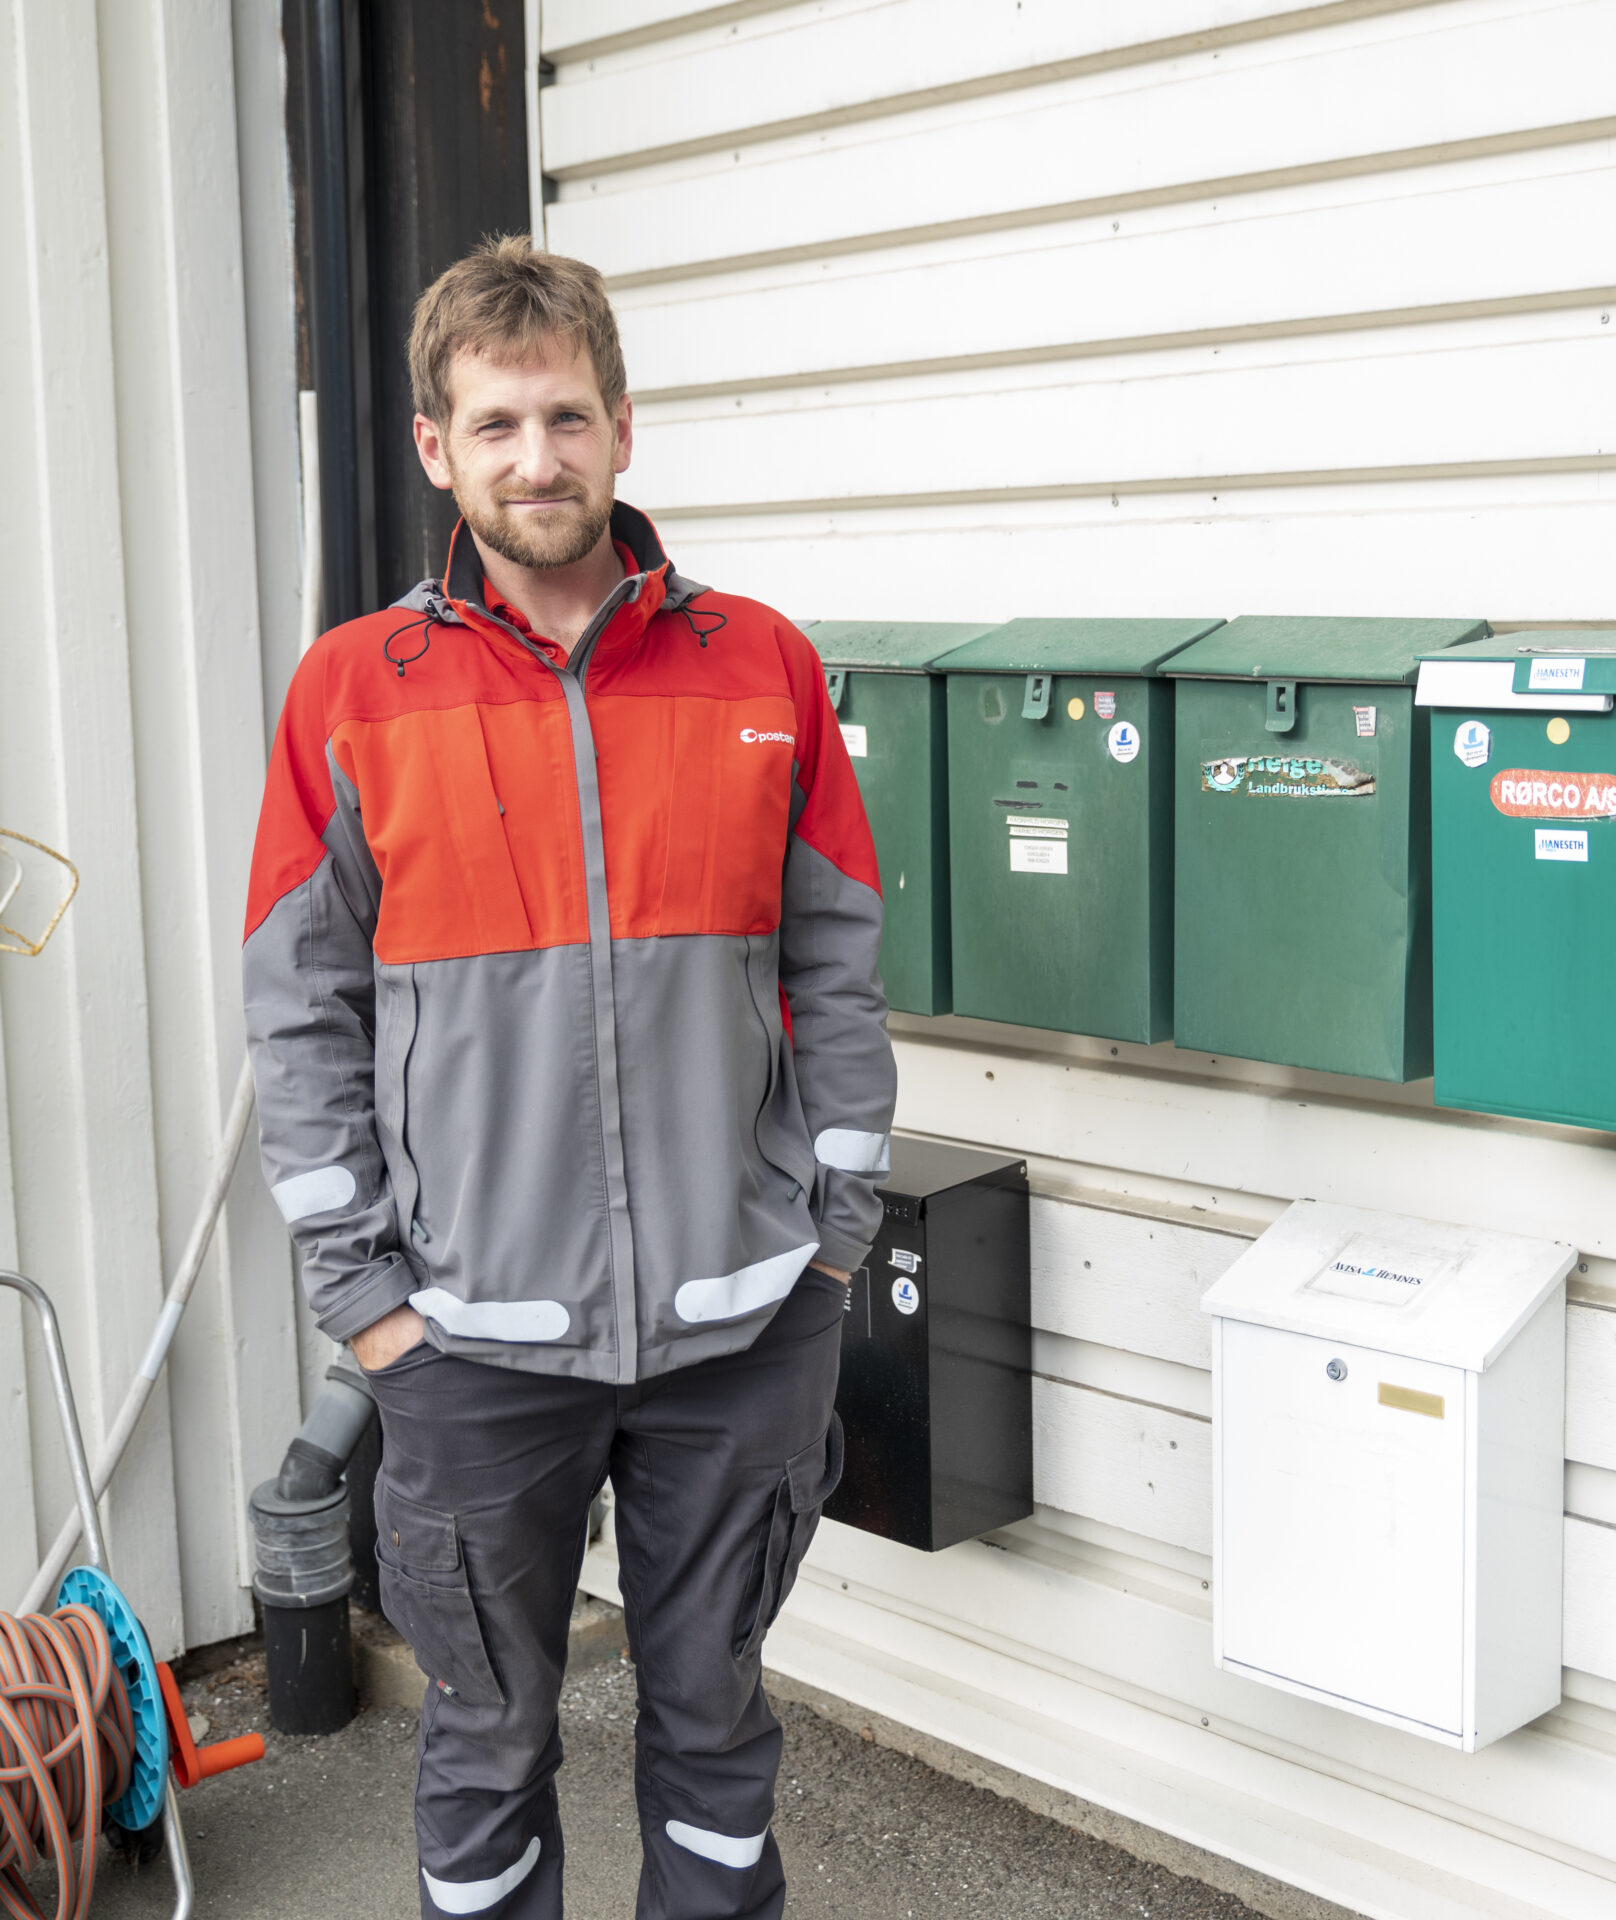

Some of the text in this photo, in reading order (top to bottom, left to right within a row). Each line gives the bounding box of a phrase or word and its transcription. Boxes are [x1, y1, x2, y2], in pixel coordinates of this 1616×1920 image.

[1536, 668, 1580, 678] HANESETH
[758, 731, 795, 745] posten
[1501, 780, 1580, 809] RØRCO
[1541, 839, 1584, 850] HANESETH
[1330, 1262, 1423, 1285] AVISA HEMNES
